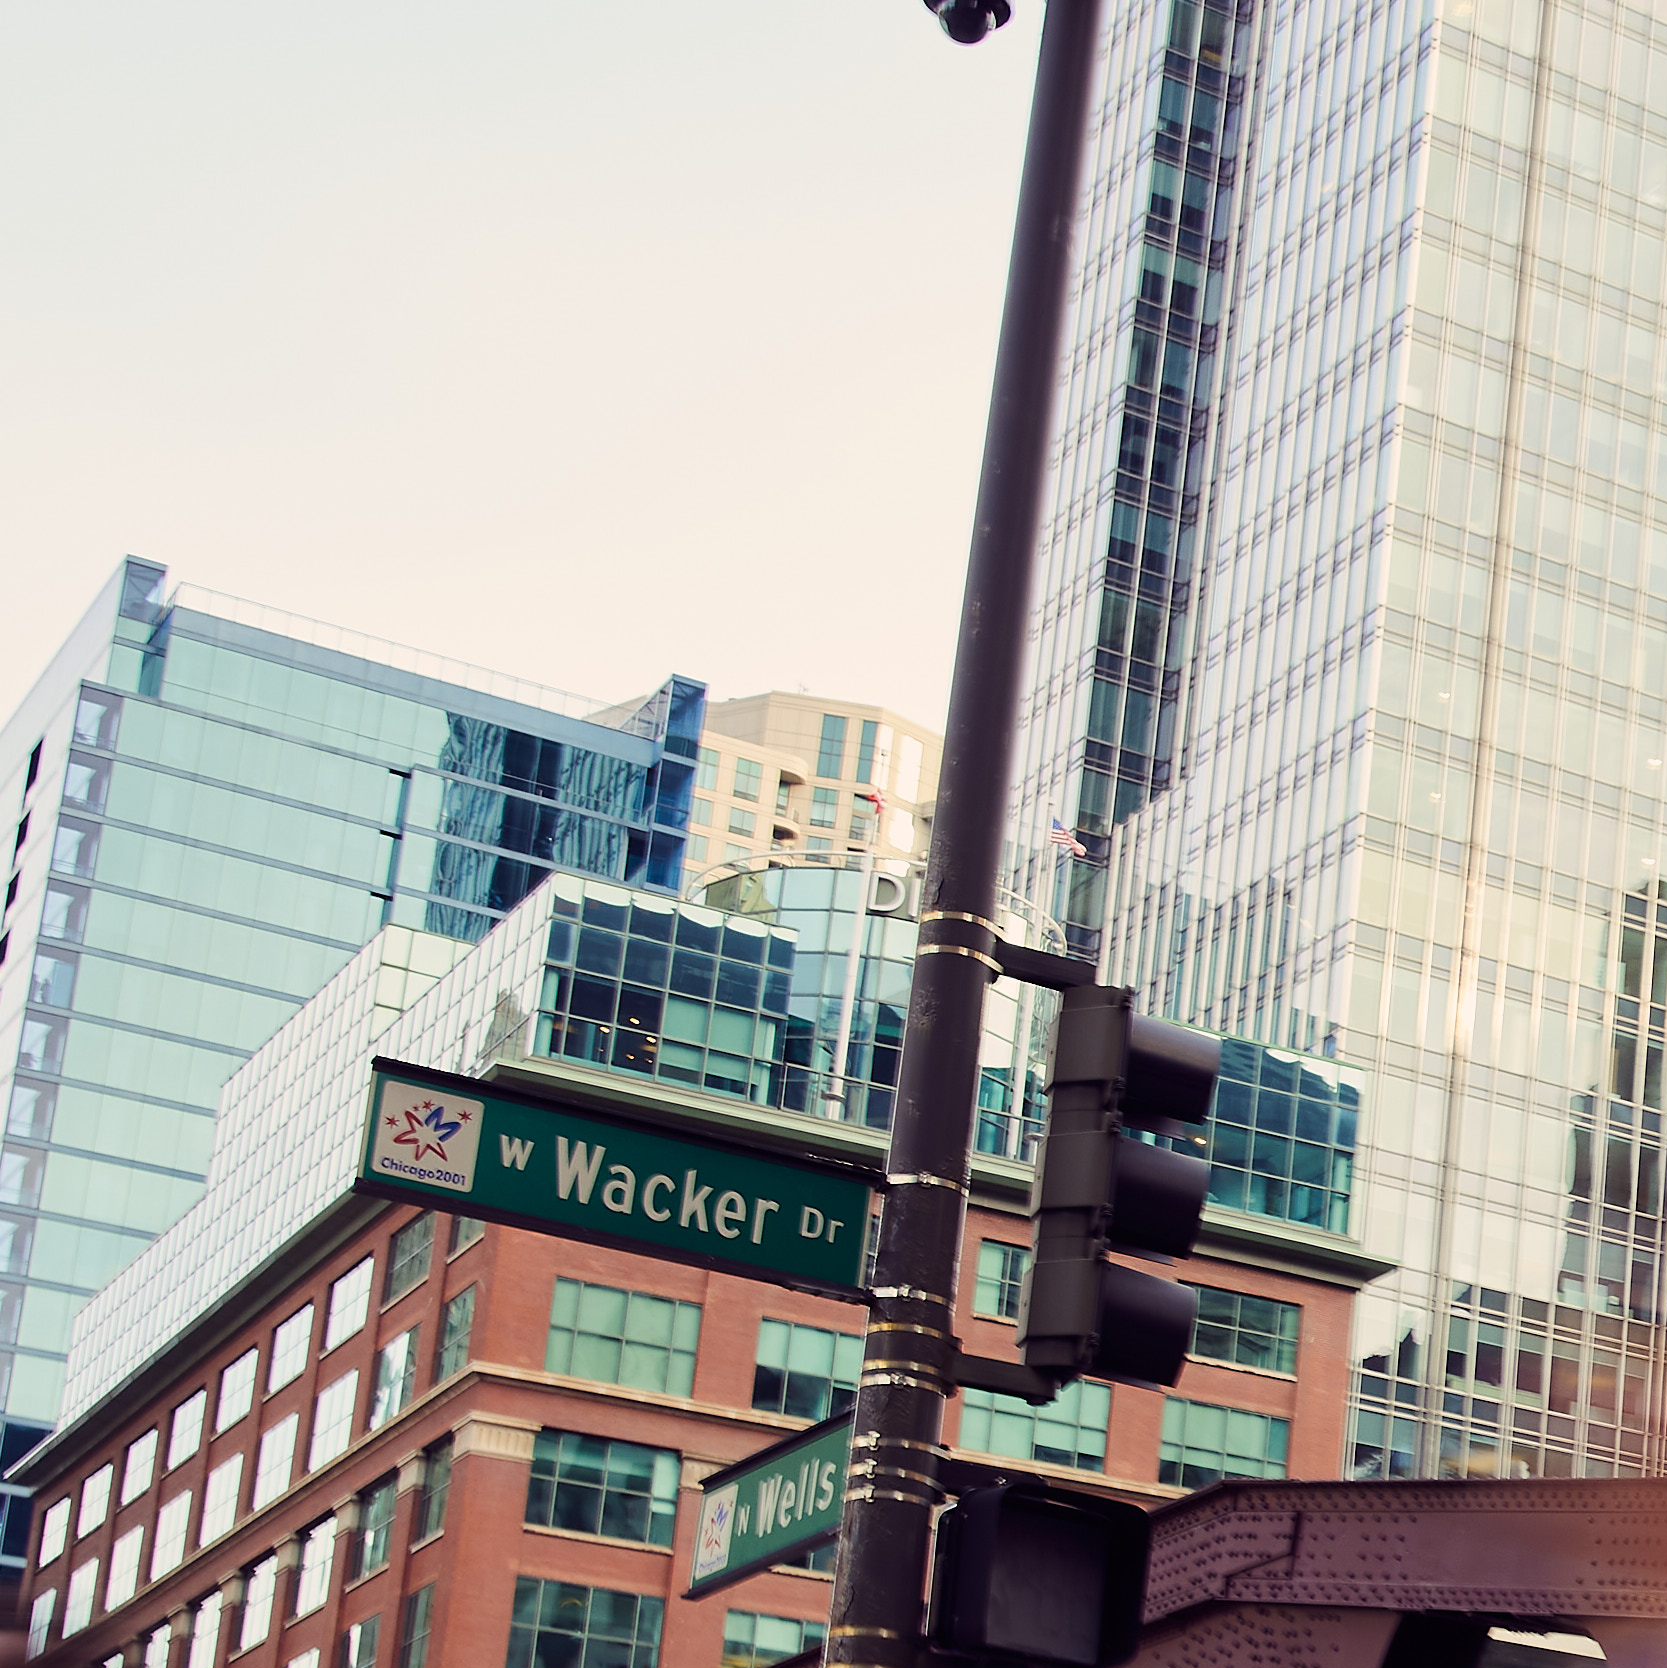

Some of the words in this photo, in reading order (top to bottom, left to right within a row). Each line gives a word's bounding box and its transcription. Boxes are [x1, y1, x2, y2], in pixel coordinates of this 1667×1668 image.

[380, 1156, 467, 1186] Chicago2001
[555, 1134, 780, 1246] Wacker
[798, 1205, 845, 1244] Dr
[737, 1503, 751, 1537] N
[755, 1457, 837, 1538] Wells
